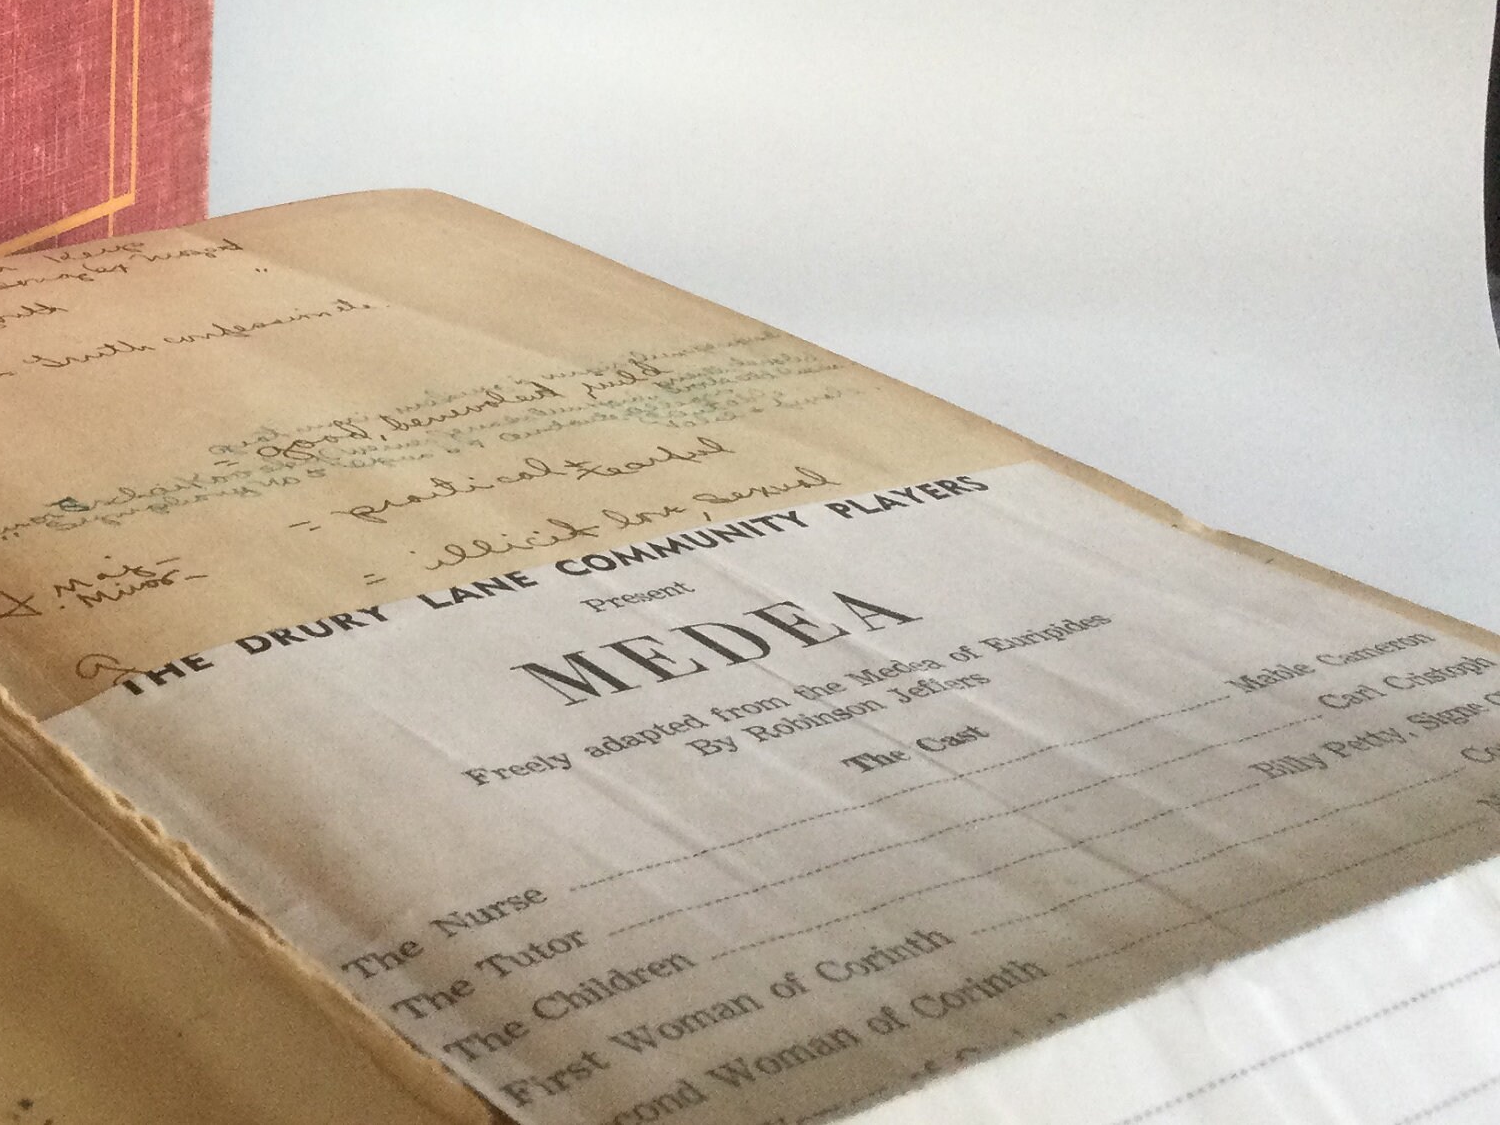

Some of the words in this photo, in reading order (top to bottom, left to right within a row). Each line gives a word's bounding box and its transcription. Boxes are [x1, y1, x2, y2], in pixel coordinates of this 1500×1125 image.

[120, 654, 215, 696] THE
[234, 605, 389, 656] DRURY
[416, 570, 539, 610] LANE
[554, 510, 809, 577] COMMUNITY
[825, 475, 989, 520] PLAYERS
[579, 581, 696, 614] Present
[509, 591, 923, 707] MEDEA
[1316, 631, 1436, 667] Cameron
[460, 752, 573, 787] Freely
[583, 713, 710, 759] adapted
[709, 696, 792, 723] from
[792, 681, 847, 701] the
[843, 658, 946, 687] Medea
[948, 644, 983, 663] of
[977, 614, 1113, 653] Euripides
[684, 736, 739, 758] By
[740, 687, 888, 744] Robinson
[1318, 683, 1387, 709] Carl
[840, 750, 907, 774] The
[915, 725, 990, 753] Cast
[1250, 751, 1329, 779] Billy
[1319, 726, 1419, 759] Petty,
[339, 940, 425, 980] The
[428, 887, 548, 939] Nurse
[389, 978, 476, 1020] The
[474, 929, 588, 979] Tutor
[442, 1020, 531, 1063] The
[531, 952, 698, 1021] Children
[498, 1050, 611, 1108] First
[607, 993, 765, 1054] Woman
[769, 971, 810, 1000] of
[814, 929, 956, 984] Corinth
[613, 1079, 708, 1125] cond
[705, 1023, 862, 1090] Woman
[865, 1003, 913, 1038] of
[909, 957, 1052, 1021] Corinth
